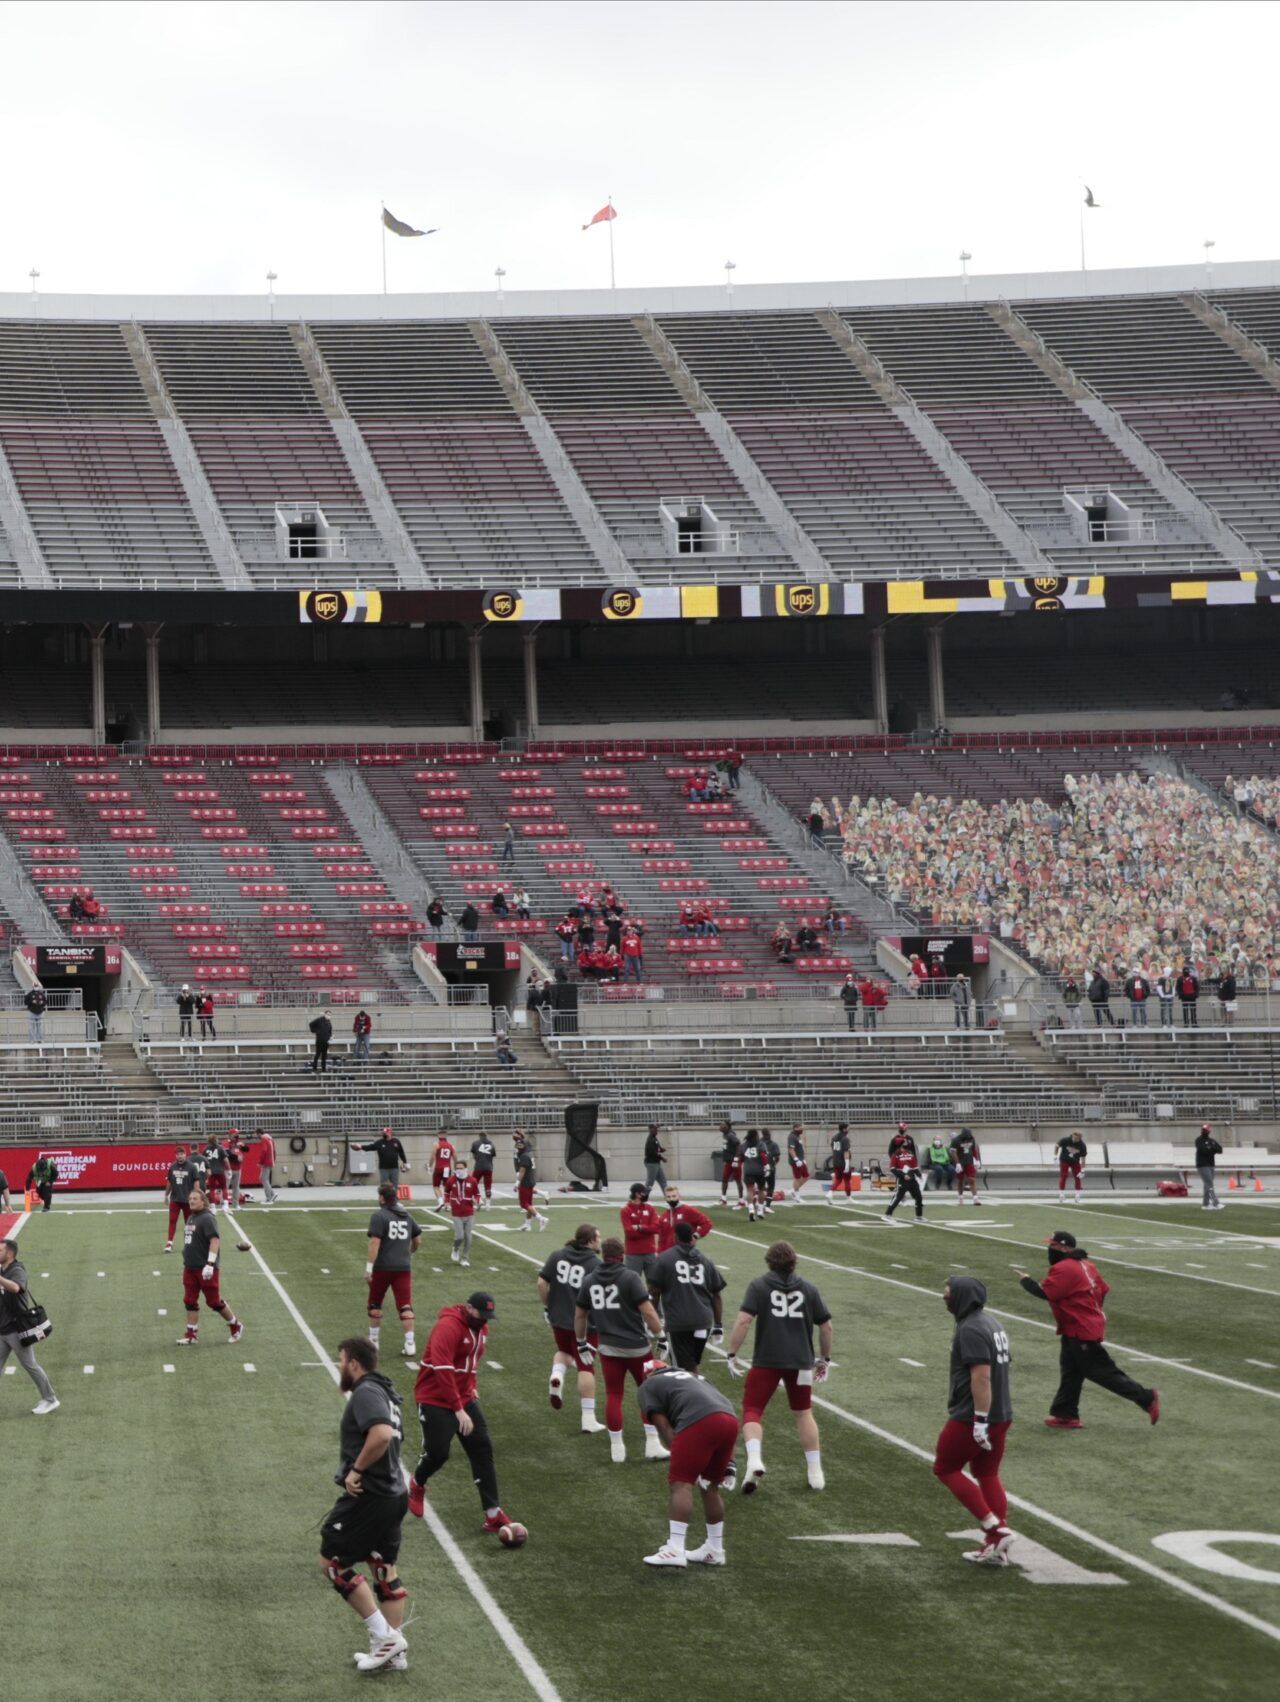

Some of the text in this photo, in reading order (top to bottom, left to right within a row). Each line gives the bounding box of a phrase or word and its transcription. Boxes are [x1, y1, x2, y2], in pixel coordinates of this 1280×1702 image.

[317, 601, 336, 616] ups
[792, 593, 813, 610] ups
[206, 1148, 218, 1159] 34
[440, 1148, 450, 1159] 13
[478, 1143, 492, 1154] 42
[112, 1162, 171, 1171] BOUNDLESS
[388, 1220, 408, 1240] 65
[556, 1260, 586, 1289] 98
[675, 1260, 705, 1285] 93
[589, 1284, 620, 1309] 82
[770, 1290, 804, 1318] 92
[993, 1331, 1009, 1364] 99
